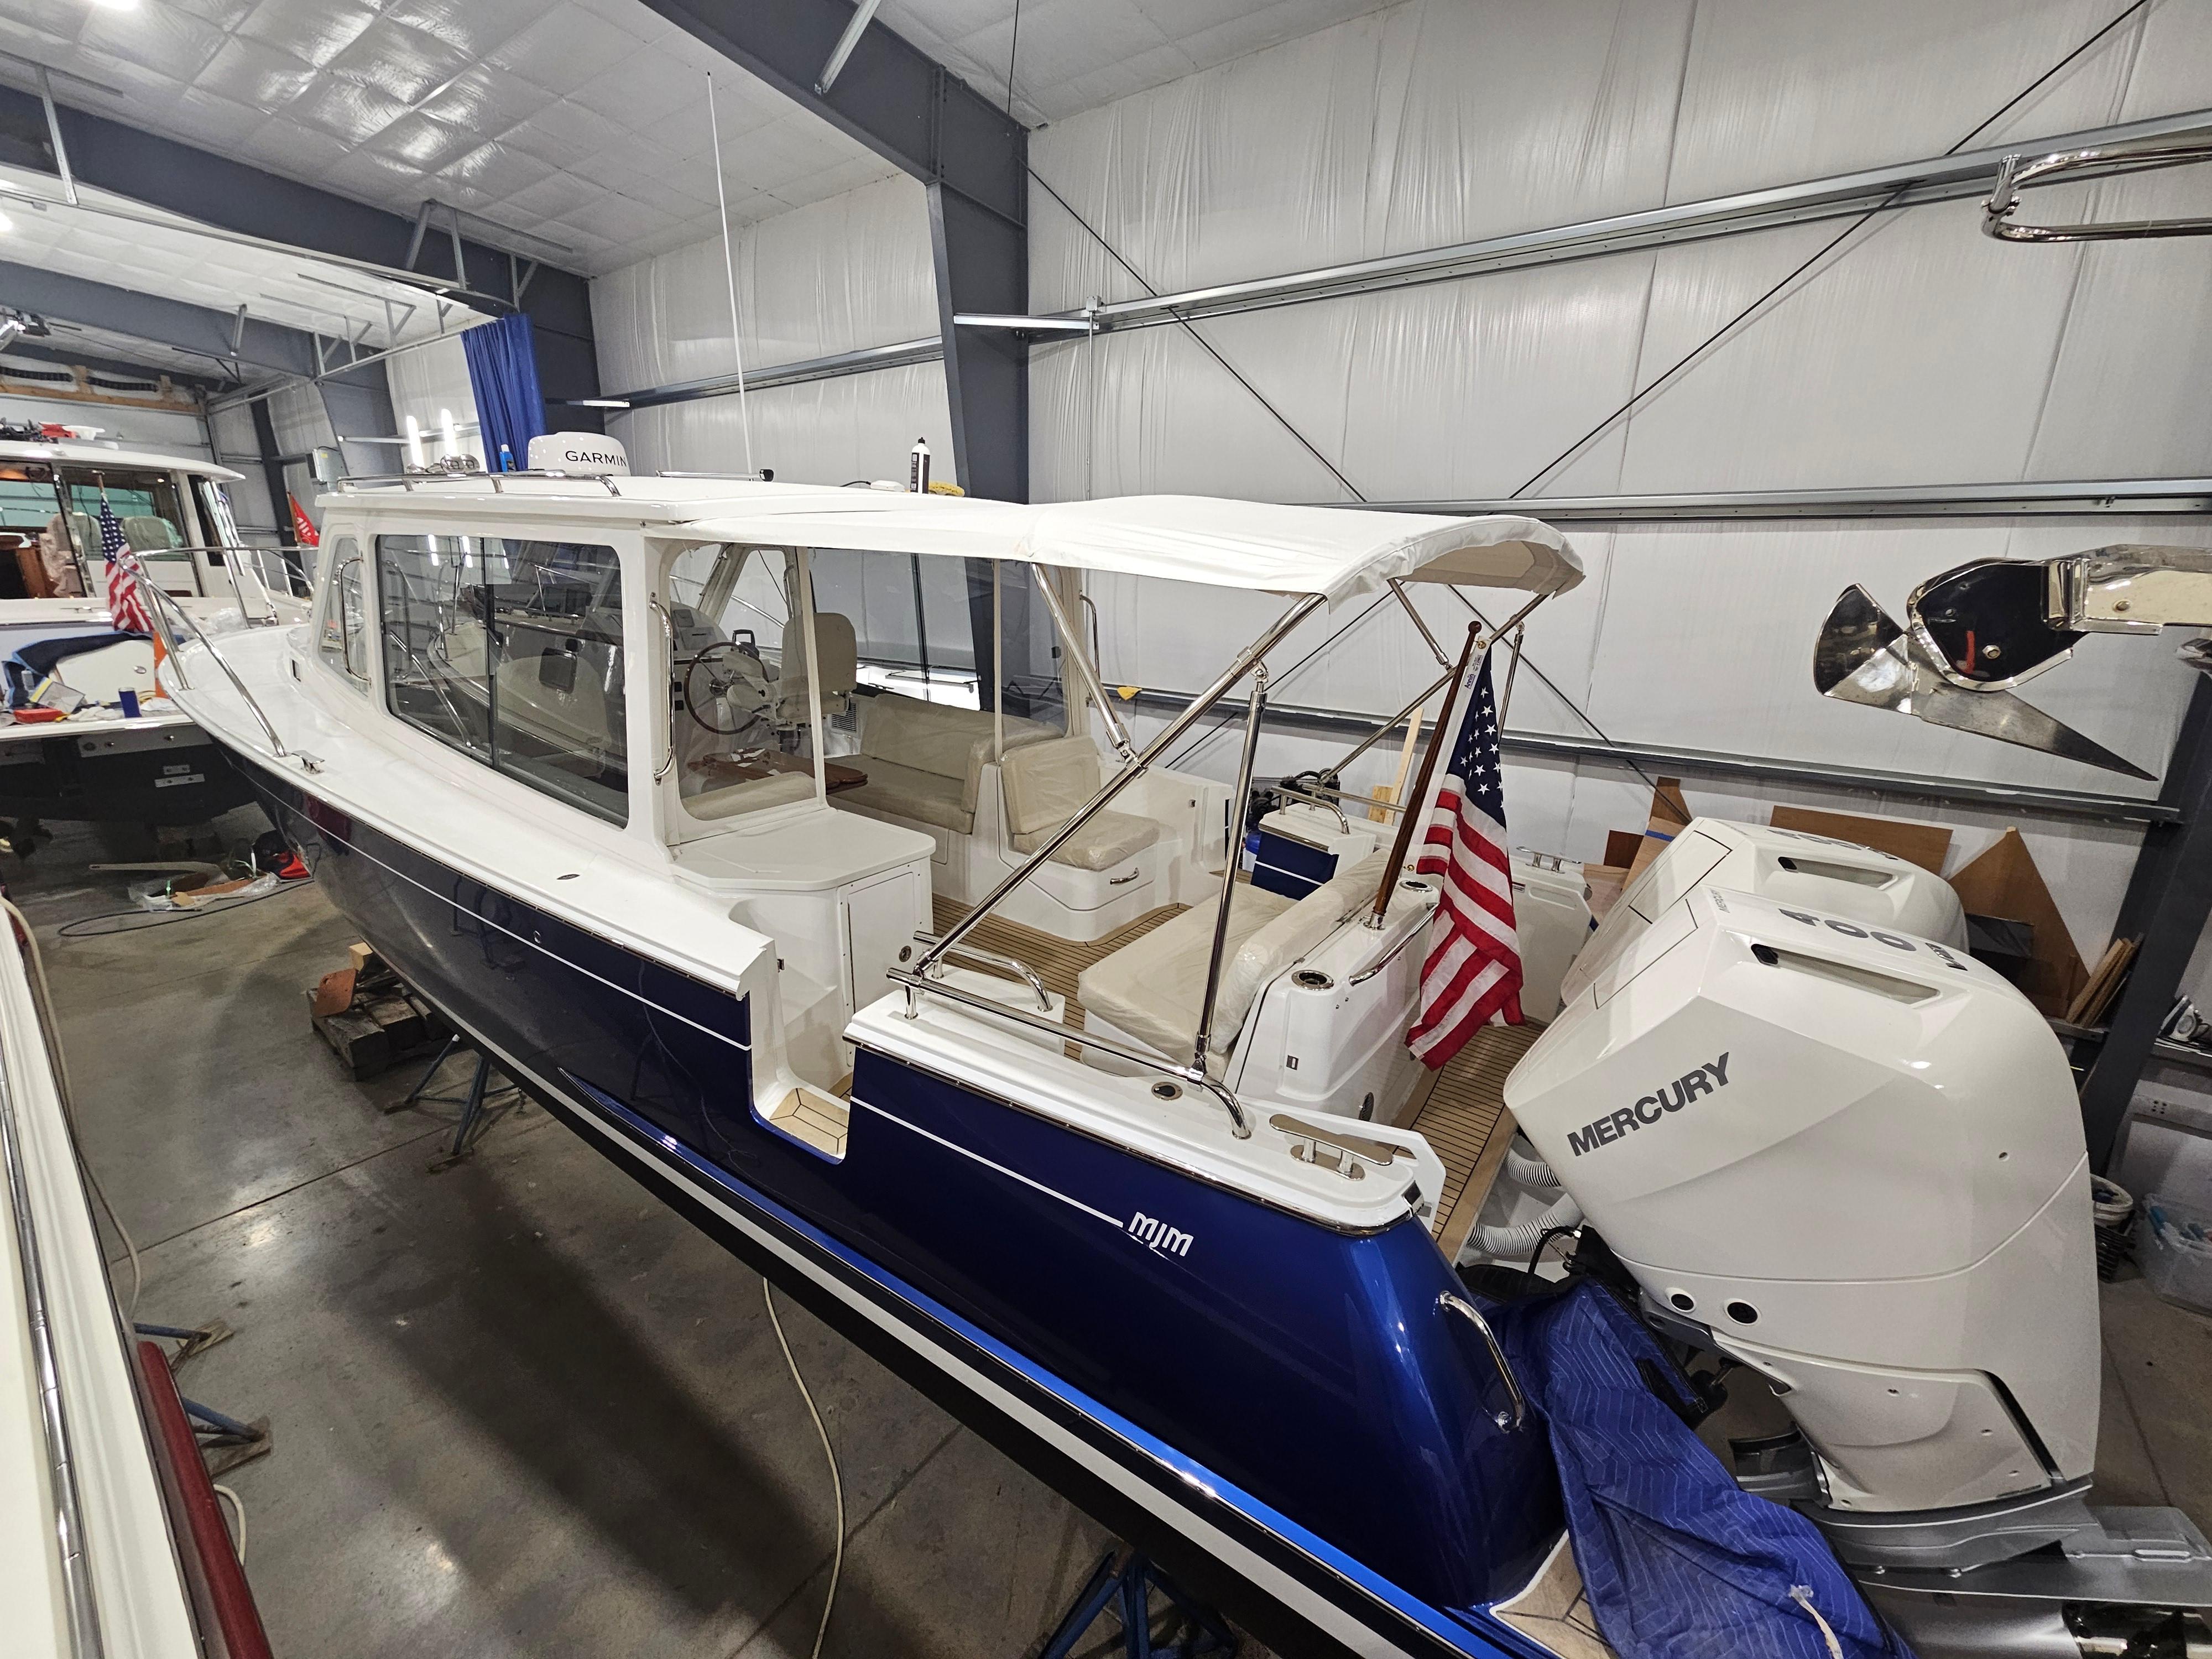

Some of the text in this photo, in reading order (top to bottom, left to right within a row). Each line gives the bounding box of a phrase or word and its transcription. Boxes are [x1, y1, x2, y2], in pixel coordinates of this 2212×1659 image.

[565, 450, 627, 467] GARMIN
[1777, 908, 1917, 952] 400
[1567, 1051, 1729, 1157] MERCURY
